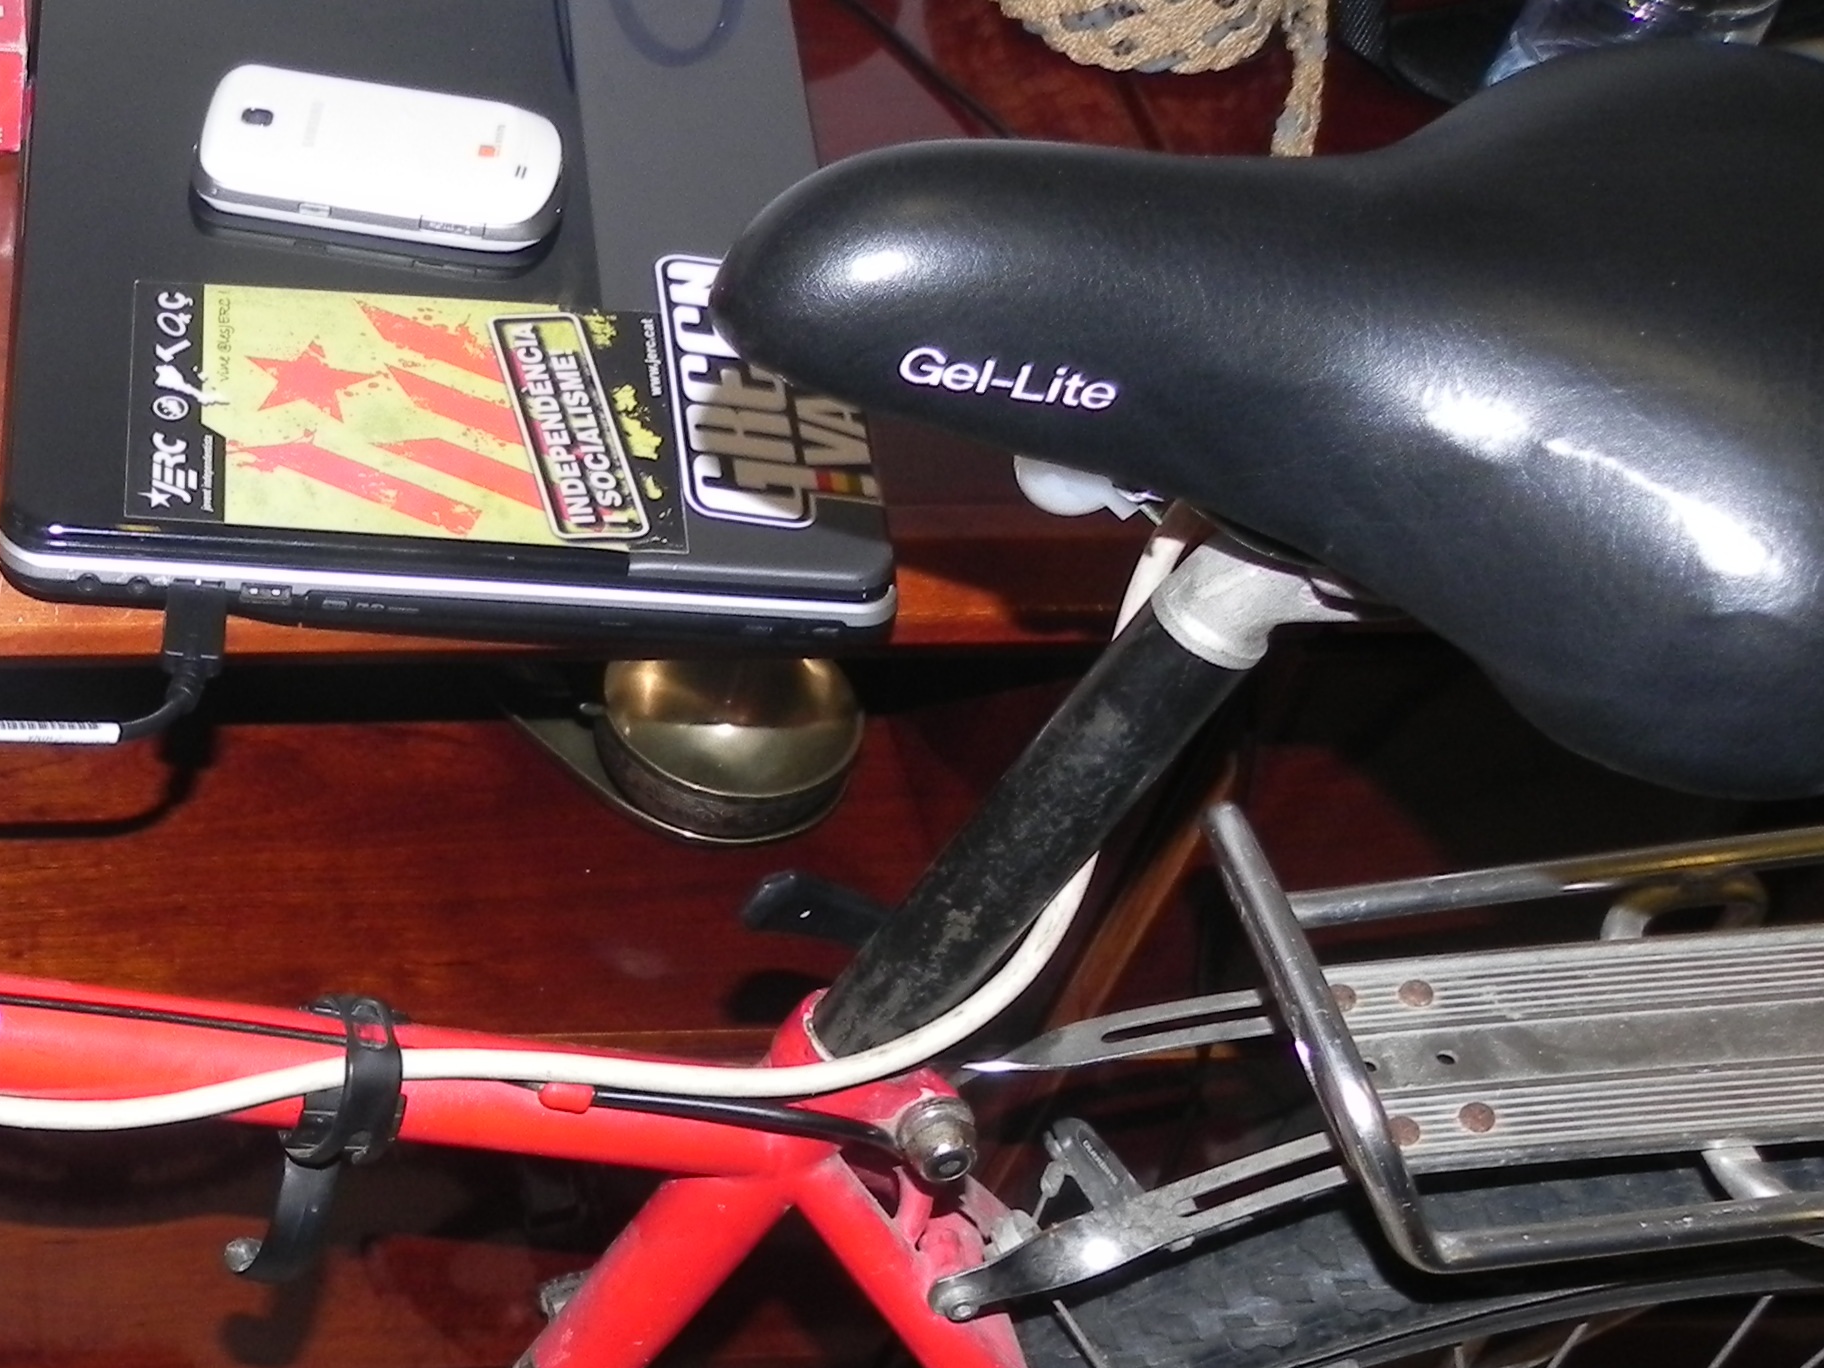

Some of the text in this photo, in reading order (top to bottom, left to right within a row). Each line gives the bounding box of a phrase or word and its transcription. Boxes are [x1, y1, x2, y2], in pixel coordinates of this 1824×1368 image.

[639, 317, 664, 397] www.jerc.cat
[898, 346, 1117, 411] Gel-Lite
[512, 322, 597, 525] INDEPENDÈNCIA
[547, 350, 623, 508] SOCIALISME!
